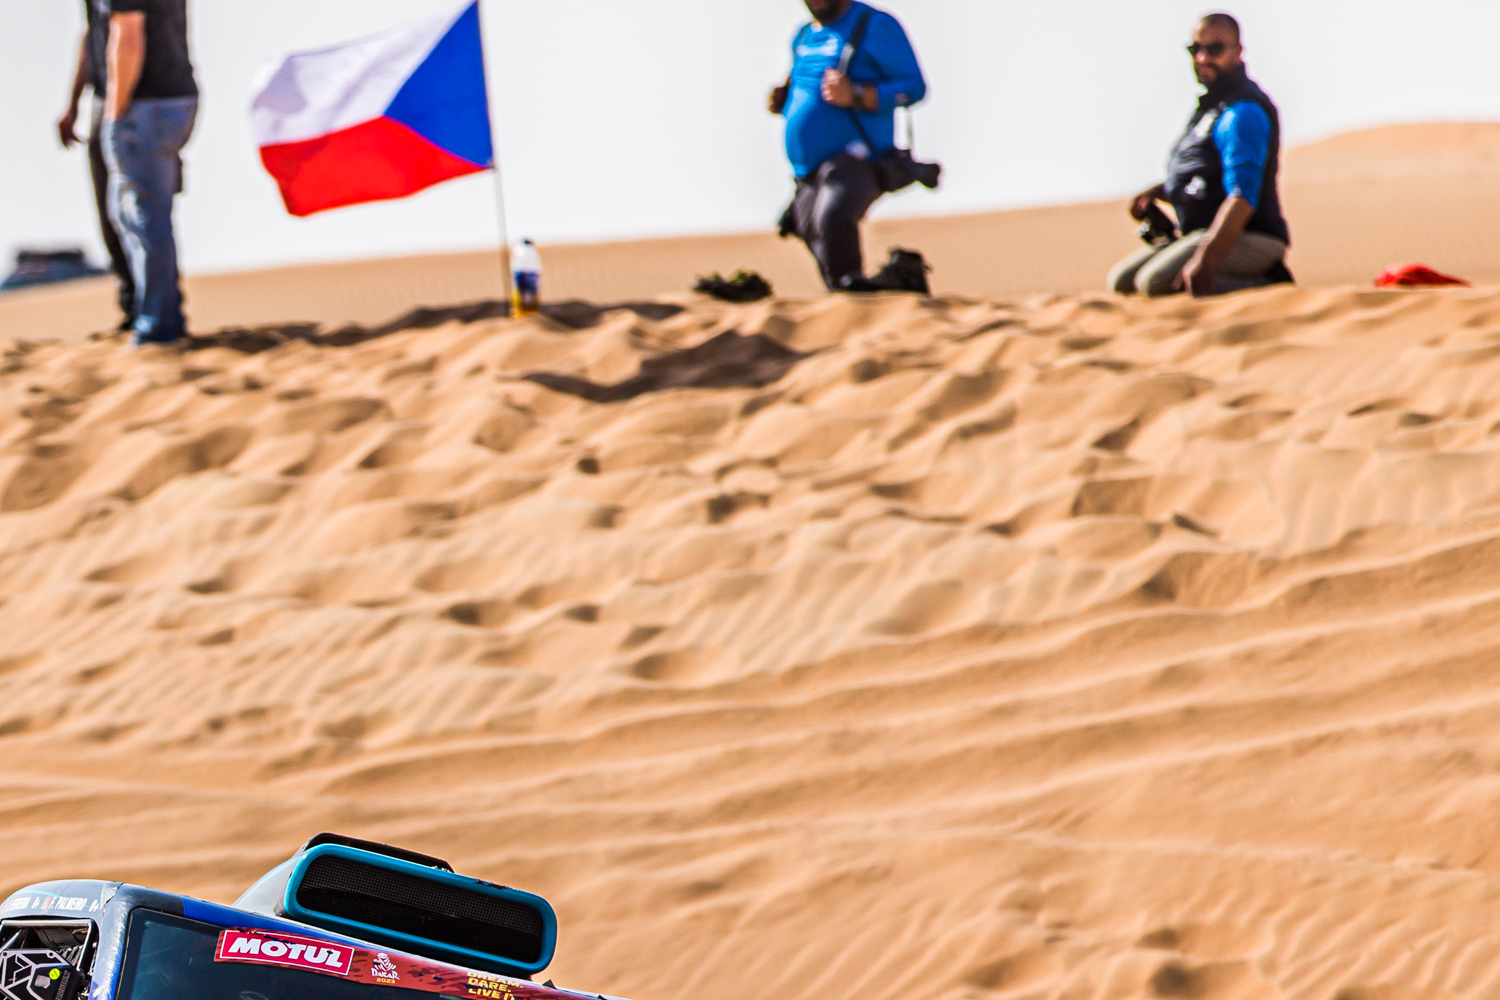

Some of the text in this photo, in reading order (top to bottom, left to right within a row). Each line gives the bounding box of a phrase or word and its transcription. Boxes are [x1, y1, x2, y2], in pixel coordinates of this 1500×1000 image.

[228, 937, 344, 968] MOTUL
[371, 967, 400, 980] DAKAR
[467, 971, 524, 988] DREAM.
[468, 977, 512, 993] DARE.
[468, 988, 502, 1000] LIVE
